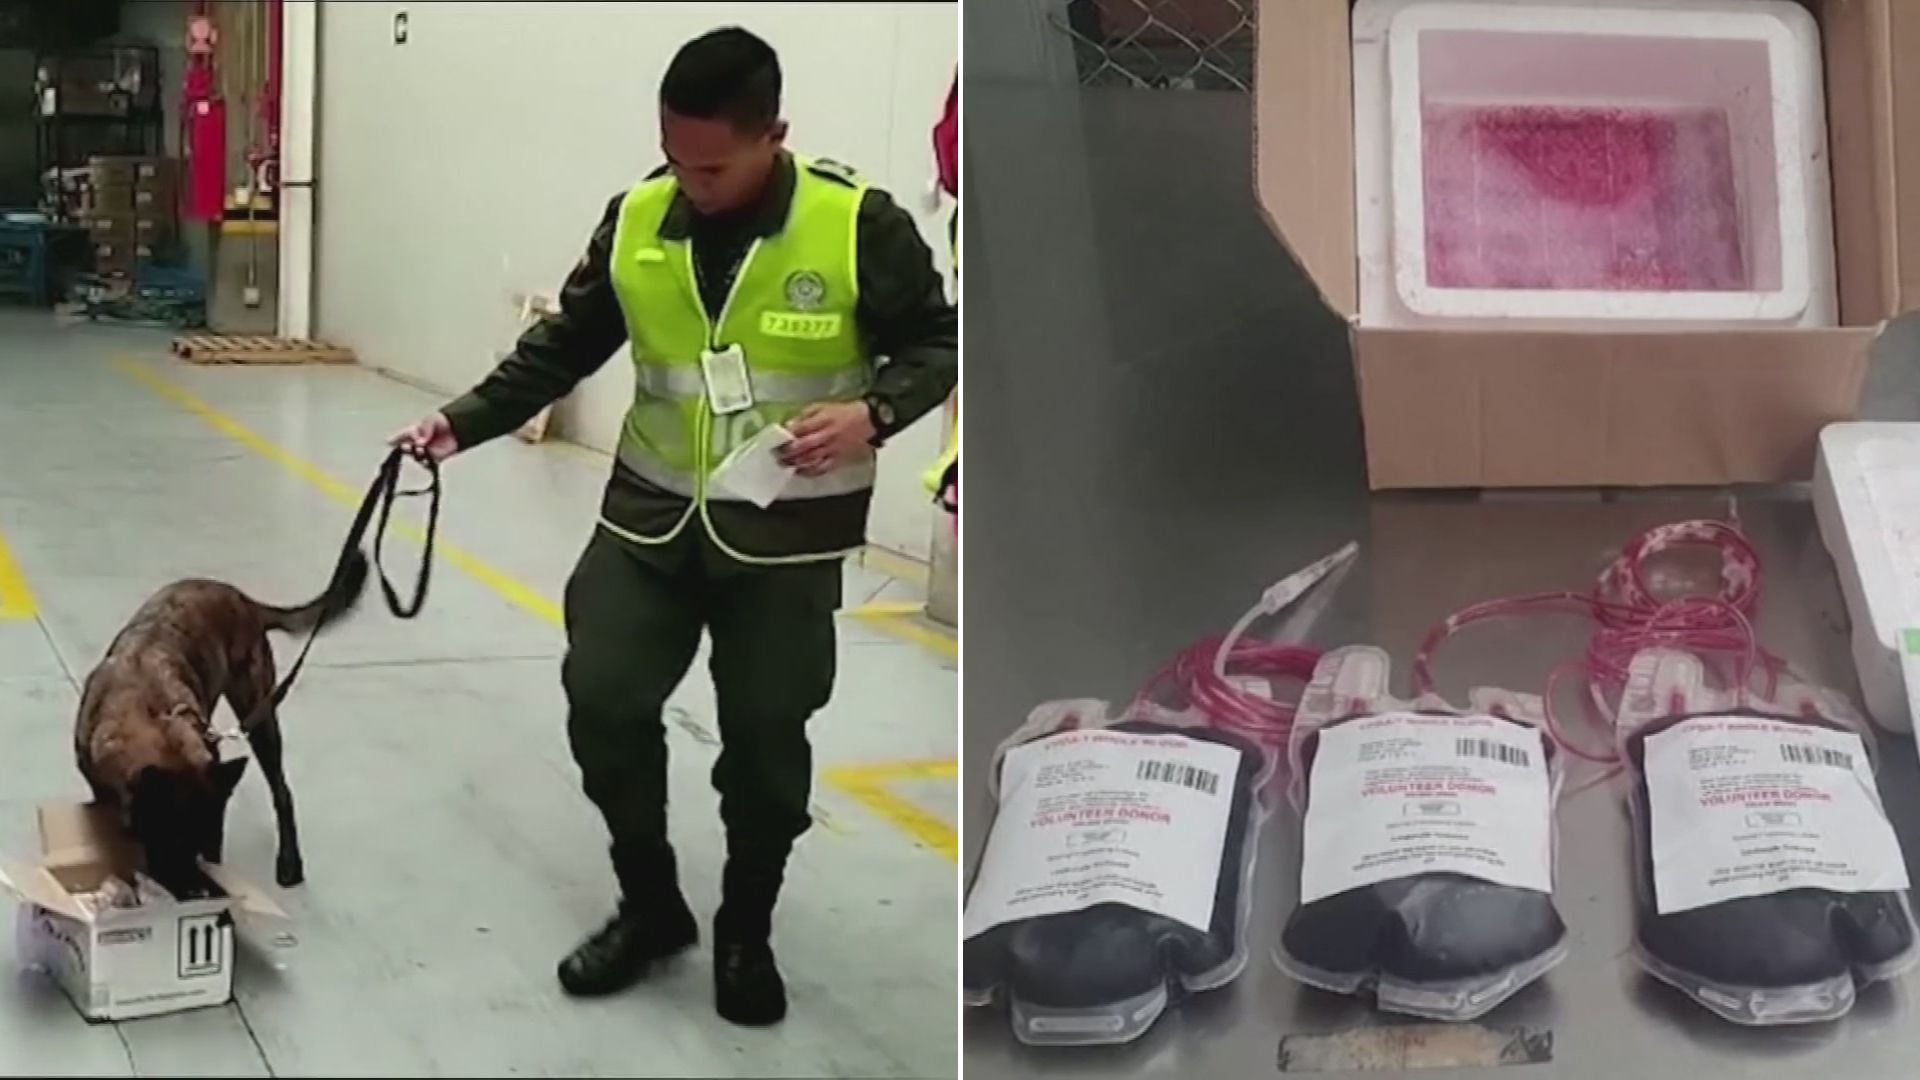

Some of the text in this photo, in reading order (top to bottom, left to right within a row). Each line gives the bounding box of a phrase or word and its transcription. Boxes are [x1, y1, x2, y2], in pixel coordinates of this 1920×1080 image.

[1360, 783, 1444, 798] VOLUNTEER
[1447, 783, 1497, 795] DONOR
[1699, 790, 1781, 807] VOLUNTEER
[1783, 789, 1831, 802] DONOR
[1030, 808, 1115, 828] VOLUNTEER
[1118, 807, 1171, 825] DONOR
